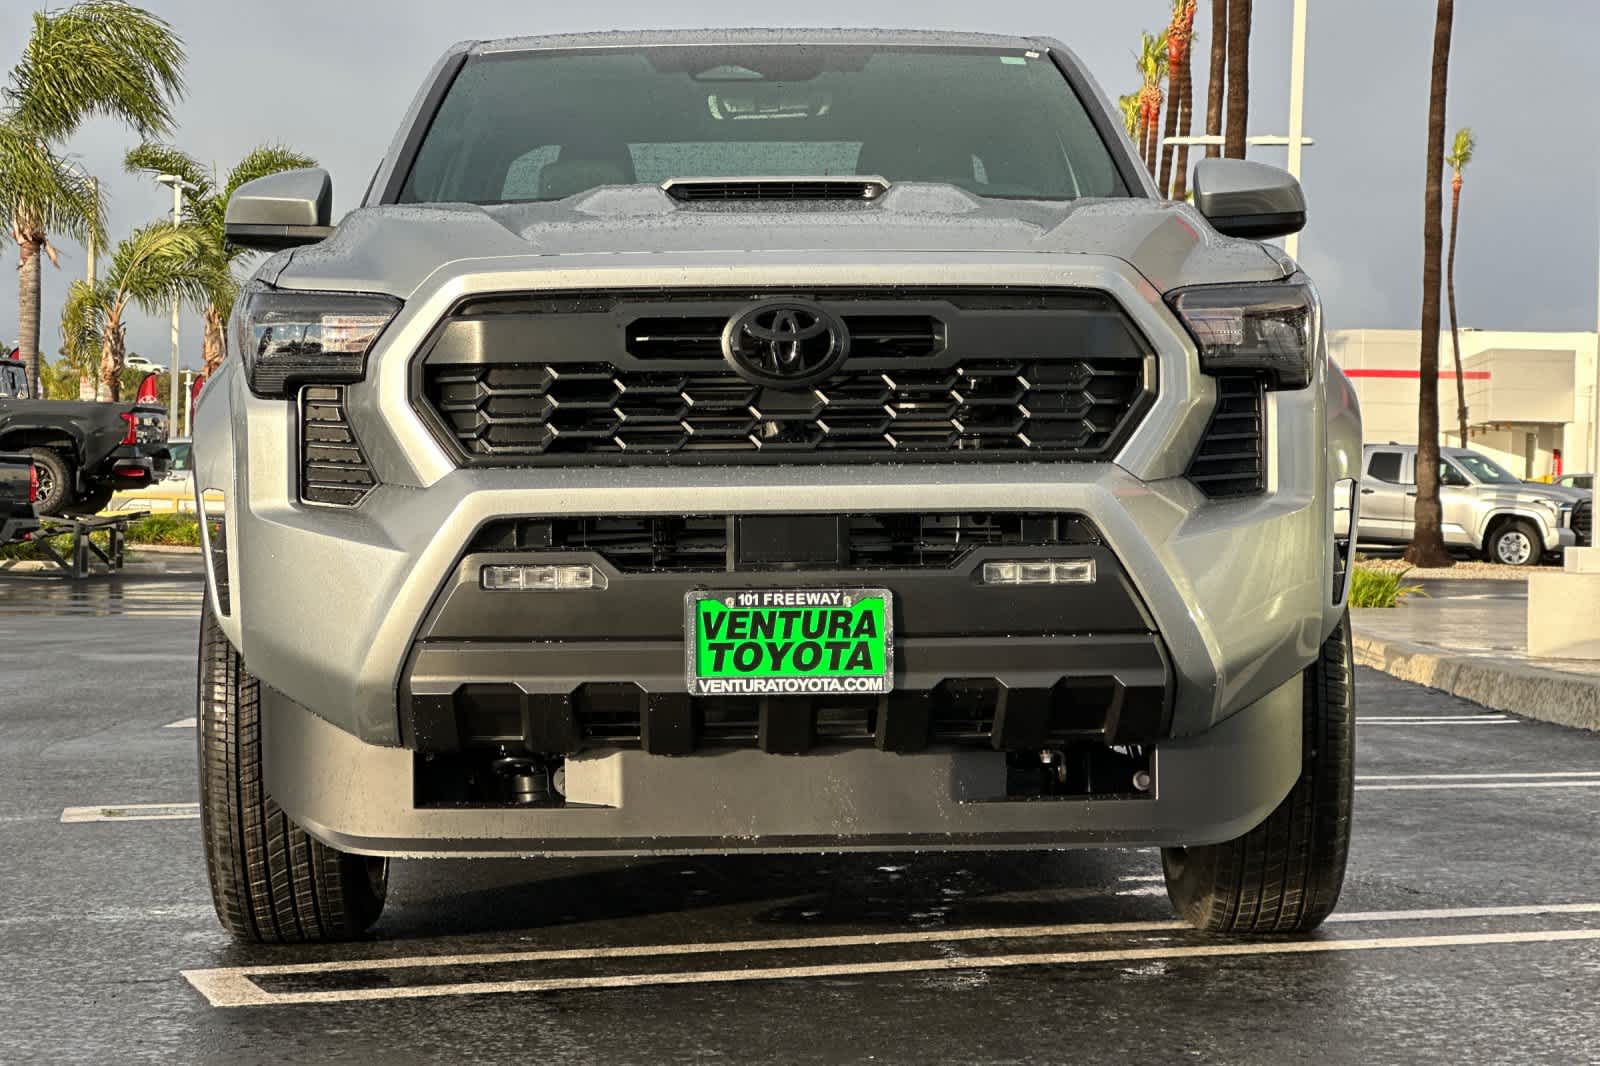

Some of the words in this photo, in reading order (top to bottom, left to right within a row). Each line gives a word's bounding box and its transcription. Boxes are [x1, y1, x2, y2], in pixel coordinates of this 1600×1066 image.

[738, 593, 759, 606] 101
[763, 592, 841, 606] FREEWAY
[702, 610, 877, 640] VENTURA
[708, 641, 873, 672] TOYOTA
[699, 677, 883, 692] VENTURATOYOTA.COM
